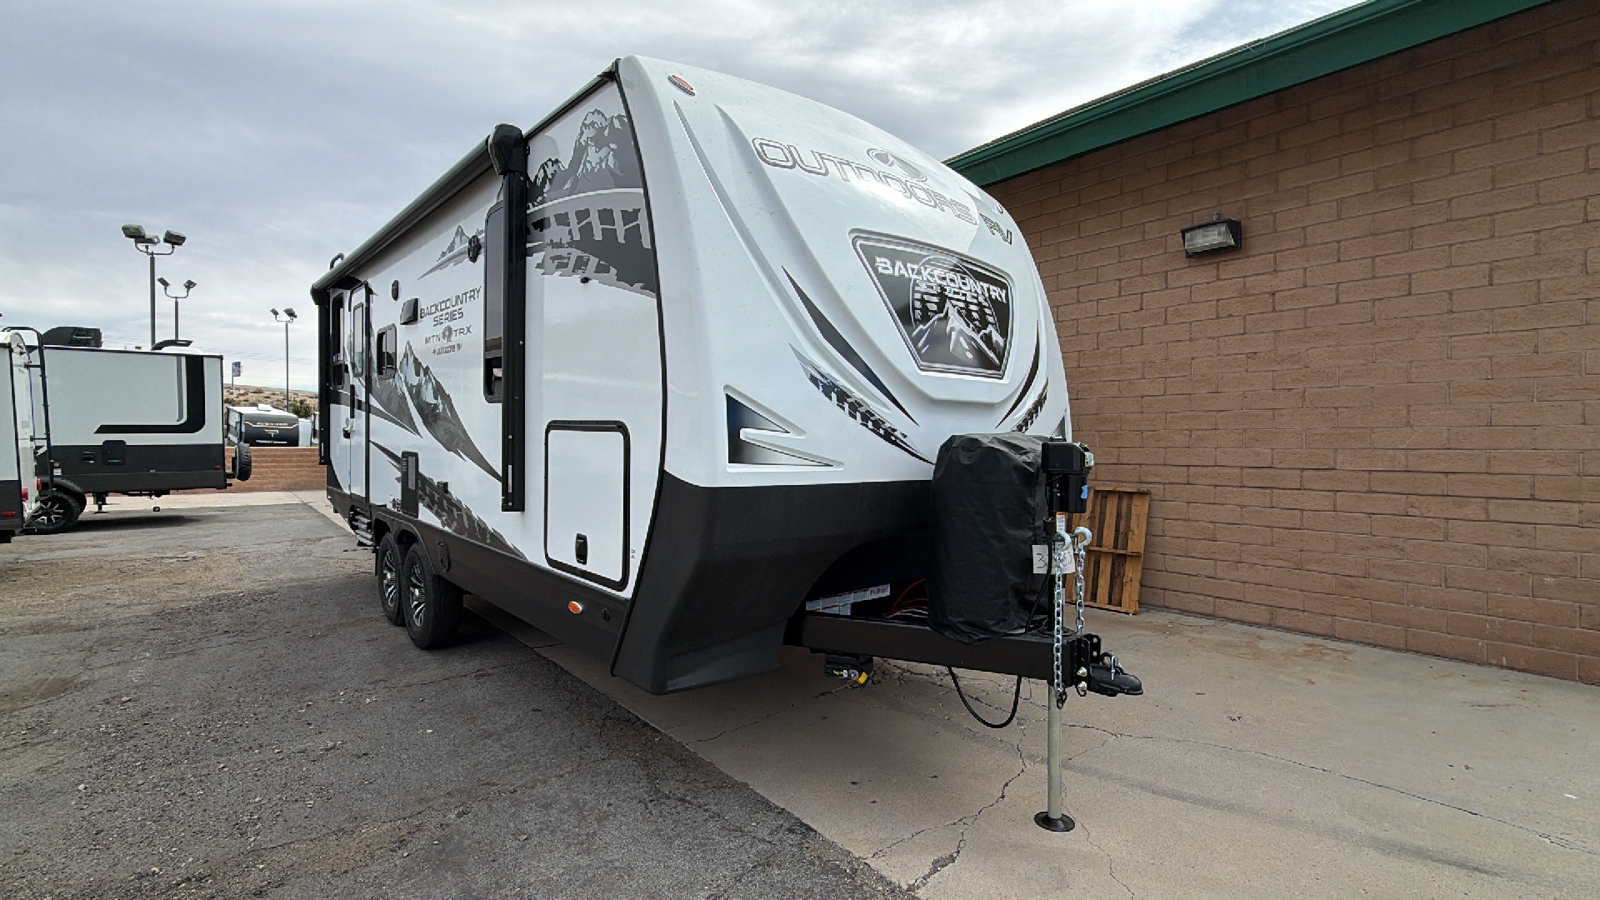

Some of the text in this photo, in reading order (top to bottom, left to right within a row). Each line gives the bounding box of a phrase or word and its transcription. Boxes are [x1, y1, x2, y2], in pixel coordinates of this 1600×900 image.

[752, 136, 978, 226] OUTDOORS
[875, 256, 1007, 303] BACKCOUNTRY
[420, 286, 482, 319] BACKCOUNTRY
[433, 307, 464, 327] SERIES
[454, 325, 471, 337] TRX
